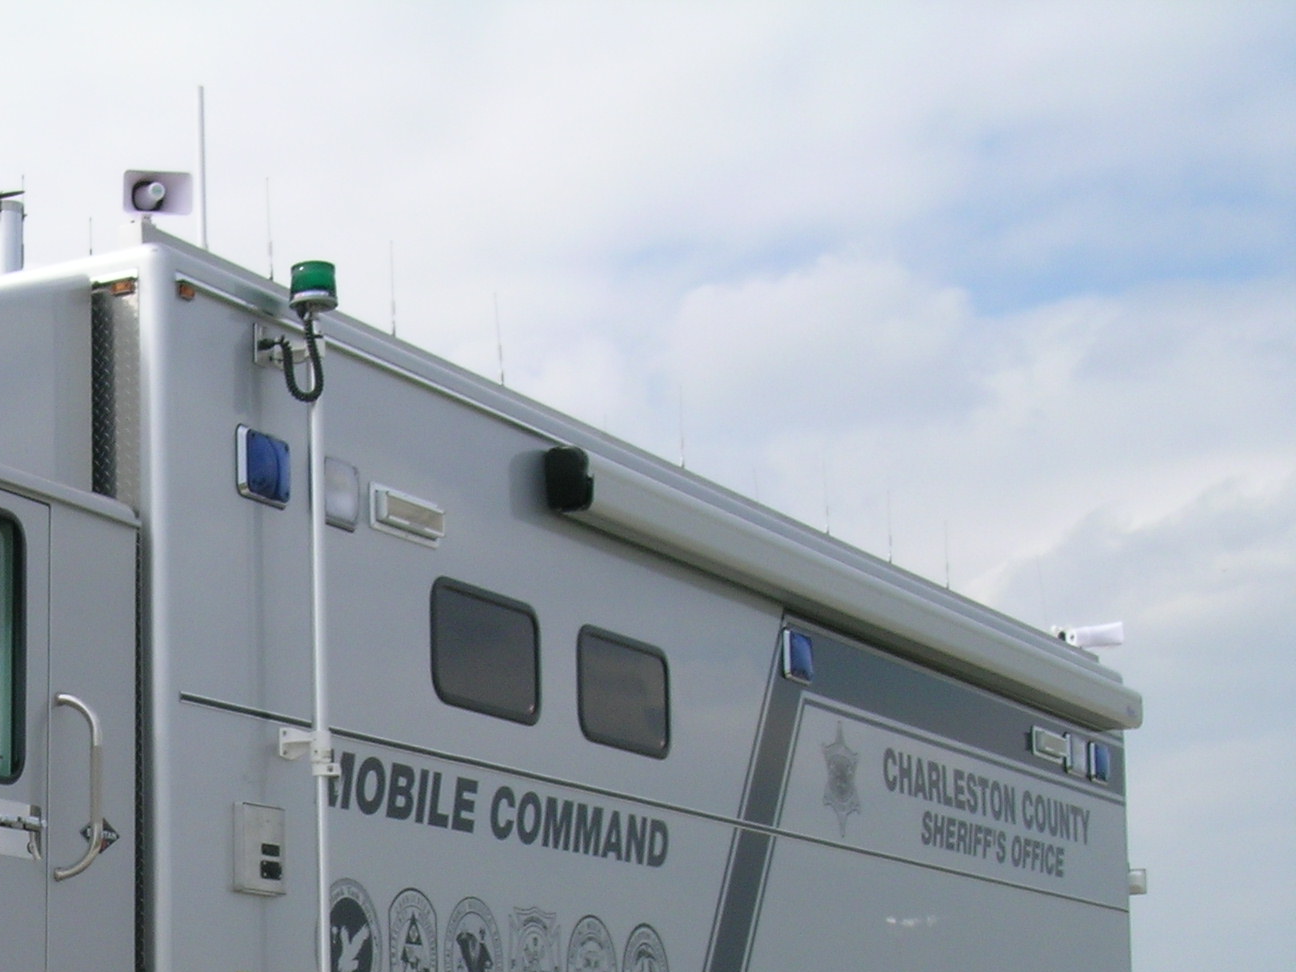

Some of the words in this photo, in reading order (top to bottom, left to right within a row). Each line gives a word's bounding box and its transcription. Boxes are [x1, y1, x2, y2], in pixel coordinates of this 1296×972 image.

[328, 748, 478, 833] MOBILE
[490, 785, 669, 867] COMMAND
[883, 747, 1016, 824] CHARLESTON
[1022, 790, 1090, 845] COUNTY
[921, 810, 1006, 864] SHERIFF'S
[1011, 835, 1065, 877] OFFICE
